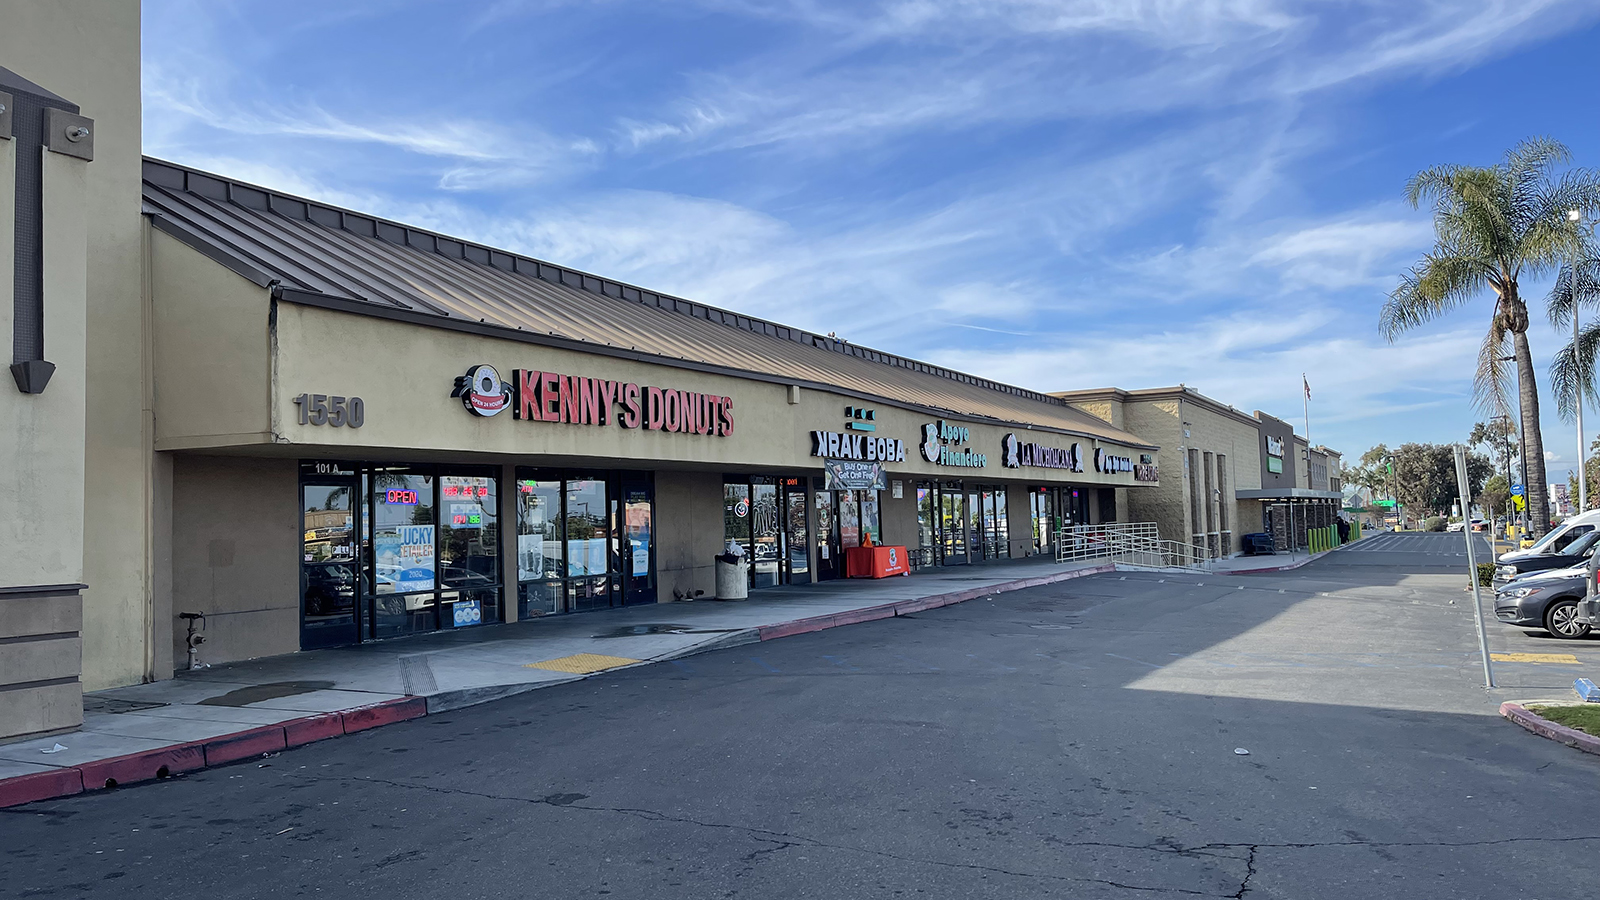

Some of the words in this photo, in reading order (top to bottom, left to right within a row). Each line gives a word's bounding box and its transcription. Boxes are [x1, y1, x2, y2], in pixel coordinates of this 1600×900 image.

[471, 396, 484, 406] OPEN
[517, 368, 641, 429] KENNY'S
[646, 385, 734, 437] DONUTS
[293, 393, 364, 428] 1550
[940, 419, 970, 446] Apoyo
[814, 430, 864, 460] KRAK
[866, 435, 906, 462] BOBA
[940, 445, 988, 468] Financiero
[1021, 441, 1032, 467] LA
[1032, 443, 1074, 469] MICHOACANA
[315, 463, 330, 474] 101
[332, 463, 339, 473] A
[843, 462, 856, 471] Buy
[856, 462, 869, 471] One
[838, 471, 849, 479] Get
[850, 471, 861, 479] One
[520, 485, 534, 493] ATM
[387, 489, 417, 504] OPEN
[408, 570, 423, 579] 2020
[416, 580, 431, 589] 2022
